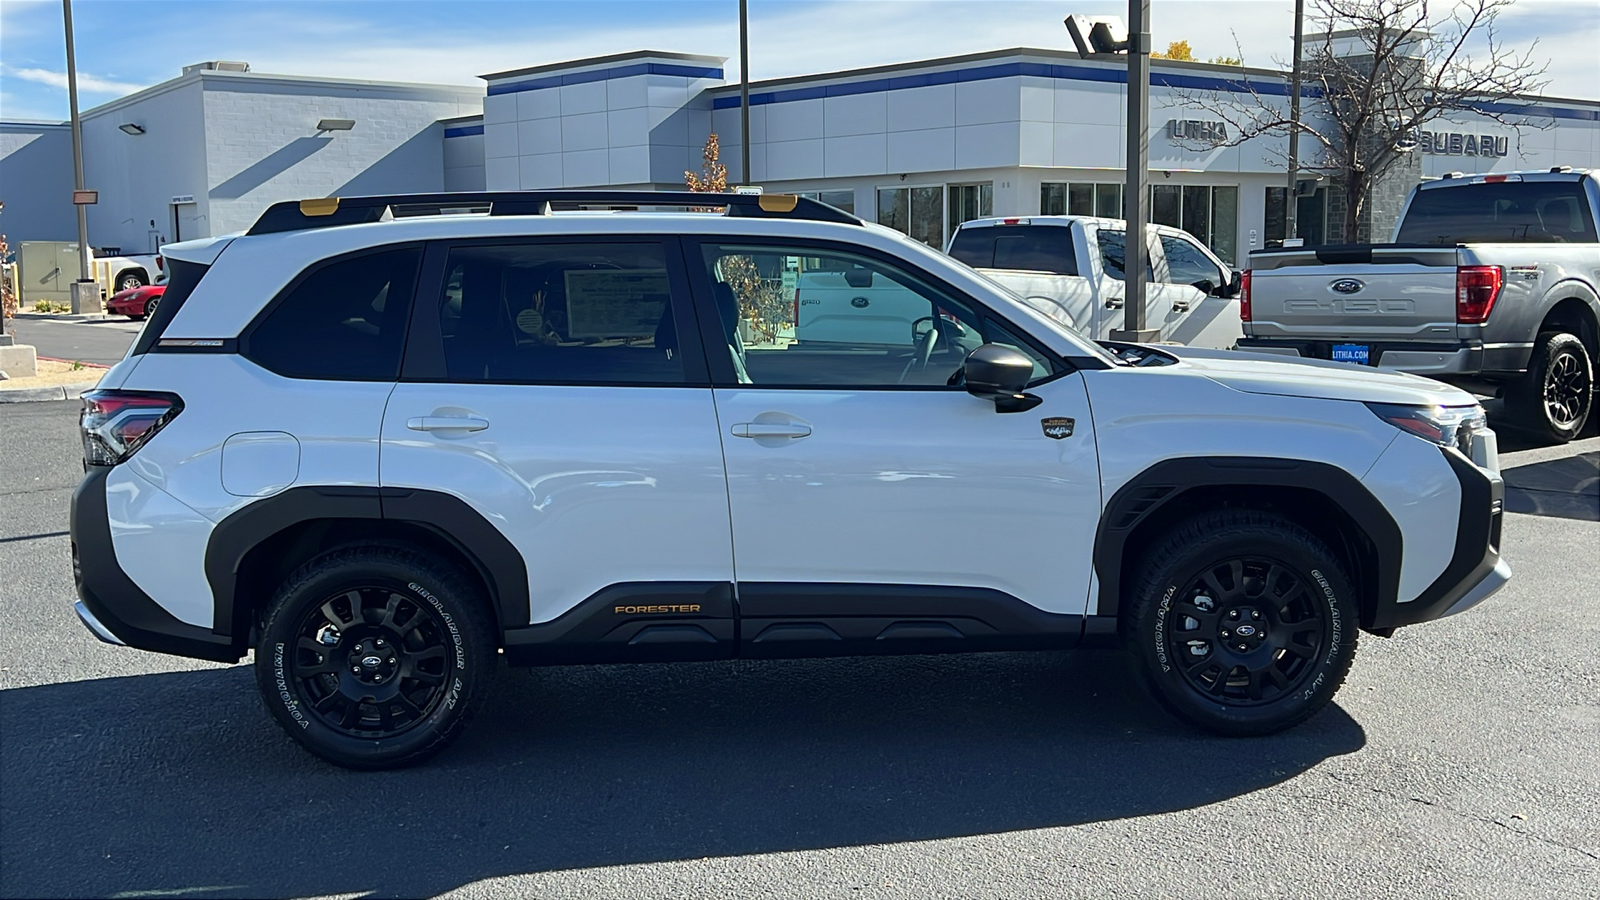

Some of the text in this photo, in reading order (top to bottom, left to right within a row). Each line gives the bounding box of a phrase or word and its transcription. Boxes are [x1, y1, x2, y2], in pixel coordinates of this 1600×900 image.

[1168, 119, 1228, 140] LITHIA
[1421, 131, 1508, 157] SUBARU
[1283, 299, 1416, 314] F-150
[1332, 350, 1369, 359] LITHIA.COM
[614, 604, 701, 614] FORESTER
[1154, 585, 1177, 673] YOKOHAMA
[407, 582, 466, 710] GEOLANDAR A/T
[273, 642, 310, 729] YOKOHAMA
